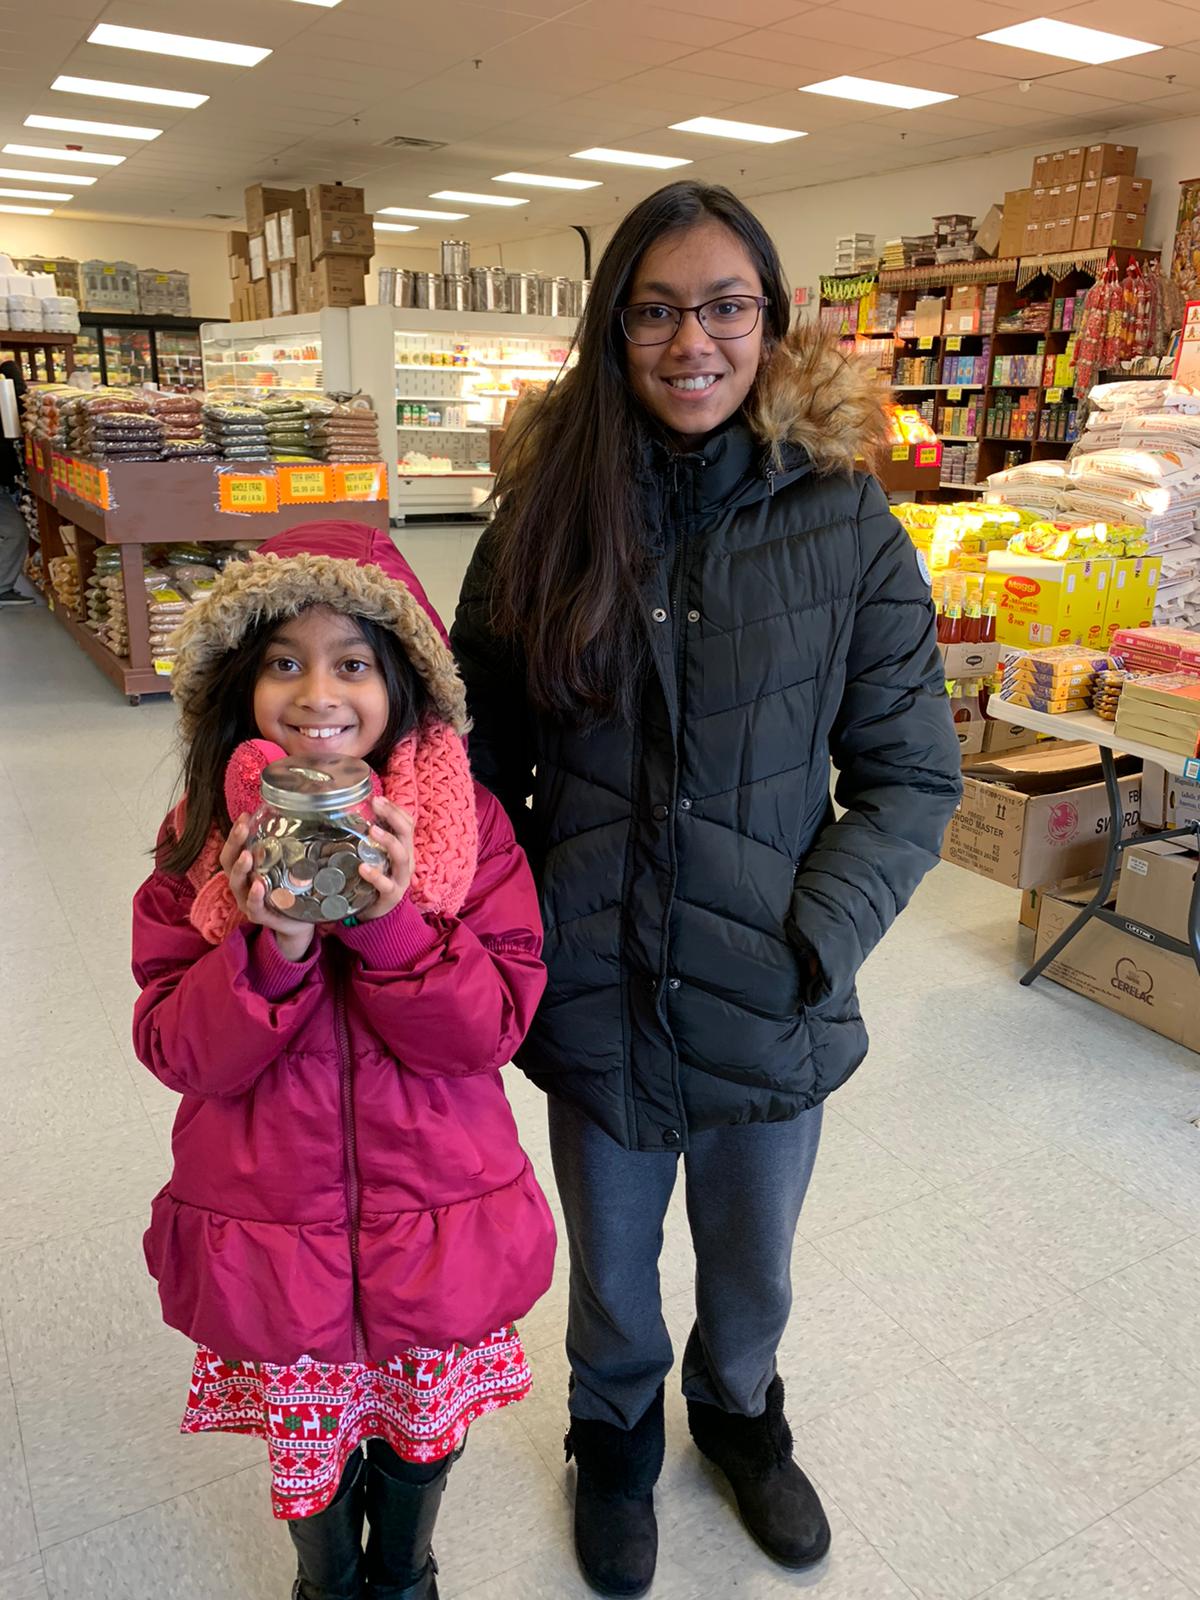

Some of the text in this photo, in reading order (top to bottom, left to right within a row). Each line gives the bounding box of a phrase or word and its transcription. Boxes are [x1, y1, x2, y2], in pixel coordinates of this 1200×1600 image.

[1008, 580, 1036, 593] Maggi
[975, 820, 1004, 838] MASTER
[1095, 810, 1140, 834] SWRD
[1111, 977, 1154, 1007] CERELAC
